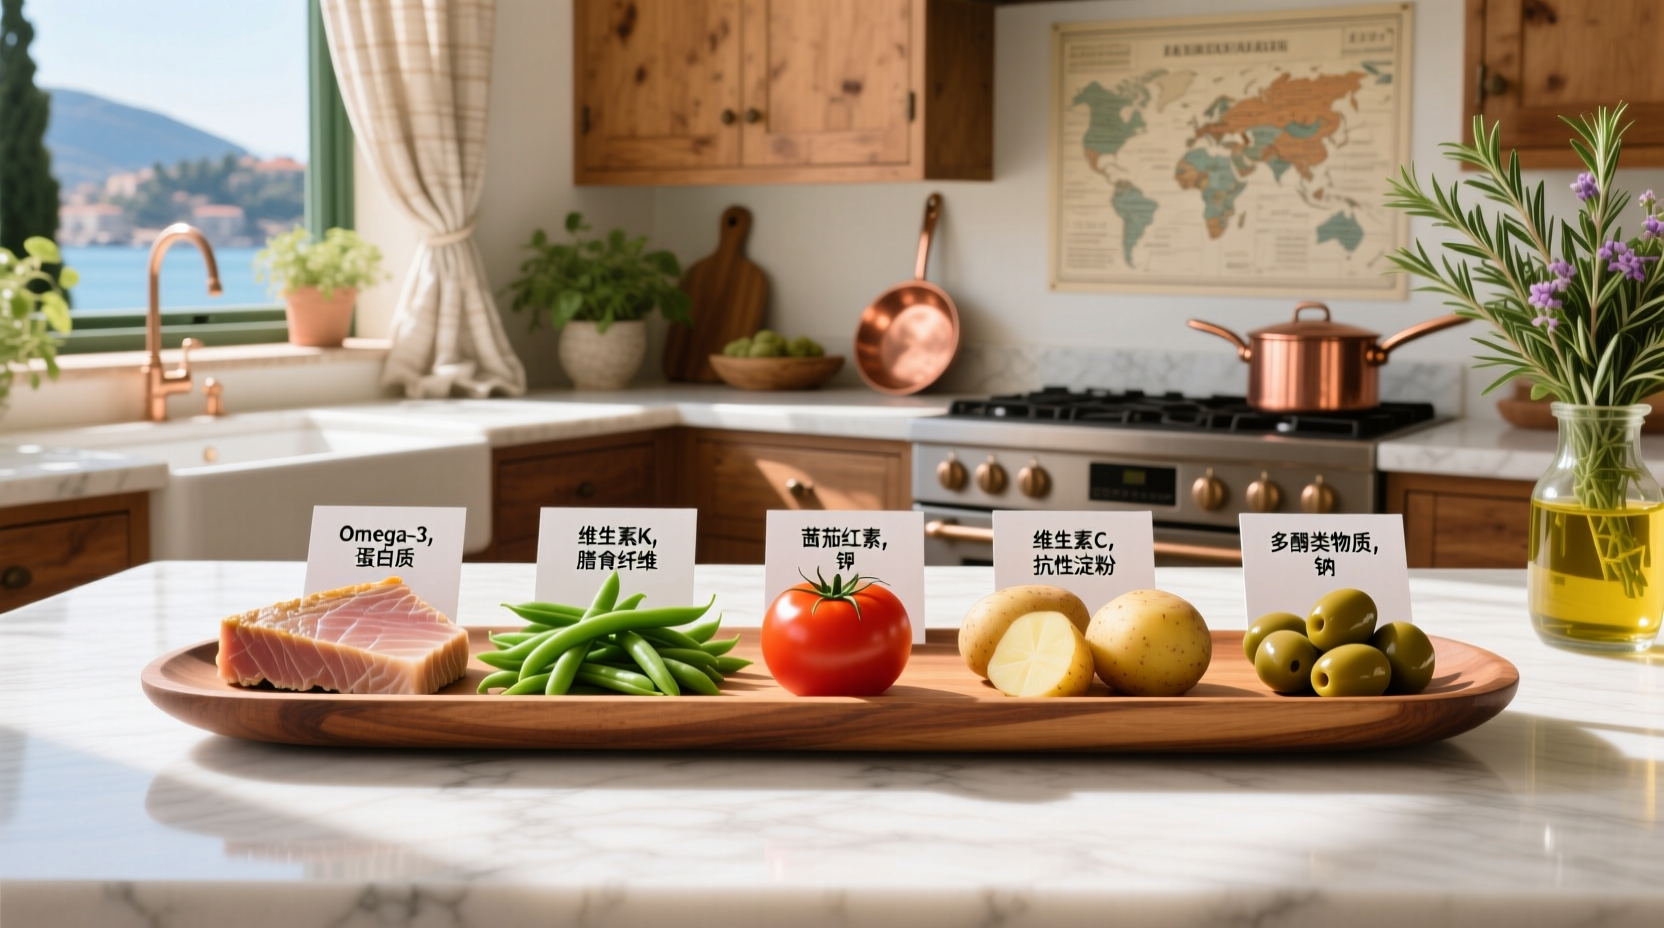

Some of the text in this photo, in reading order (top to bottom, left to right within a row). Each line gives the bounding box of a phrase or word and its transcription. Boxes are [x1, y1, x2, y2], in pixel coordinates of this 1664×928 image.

[339, 525, 433, 546] Omega-3,
[1032, 528, 1114, 551] 维生素C,
[1033, 553, 1116, 575] 抗性淀粉
